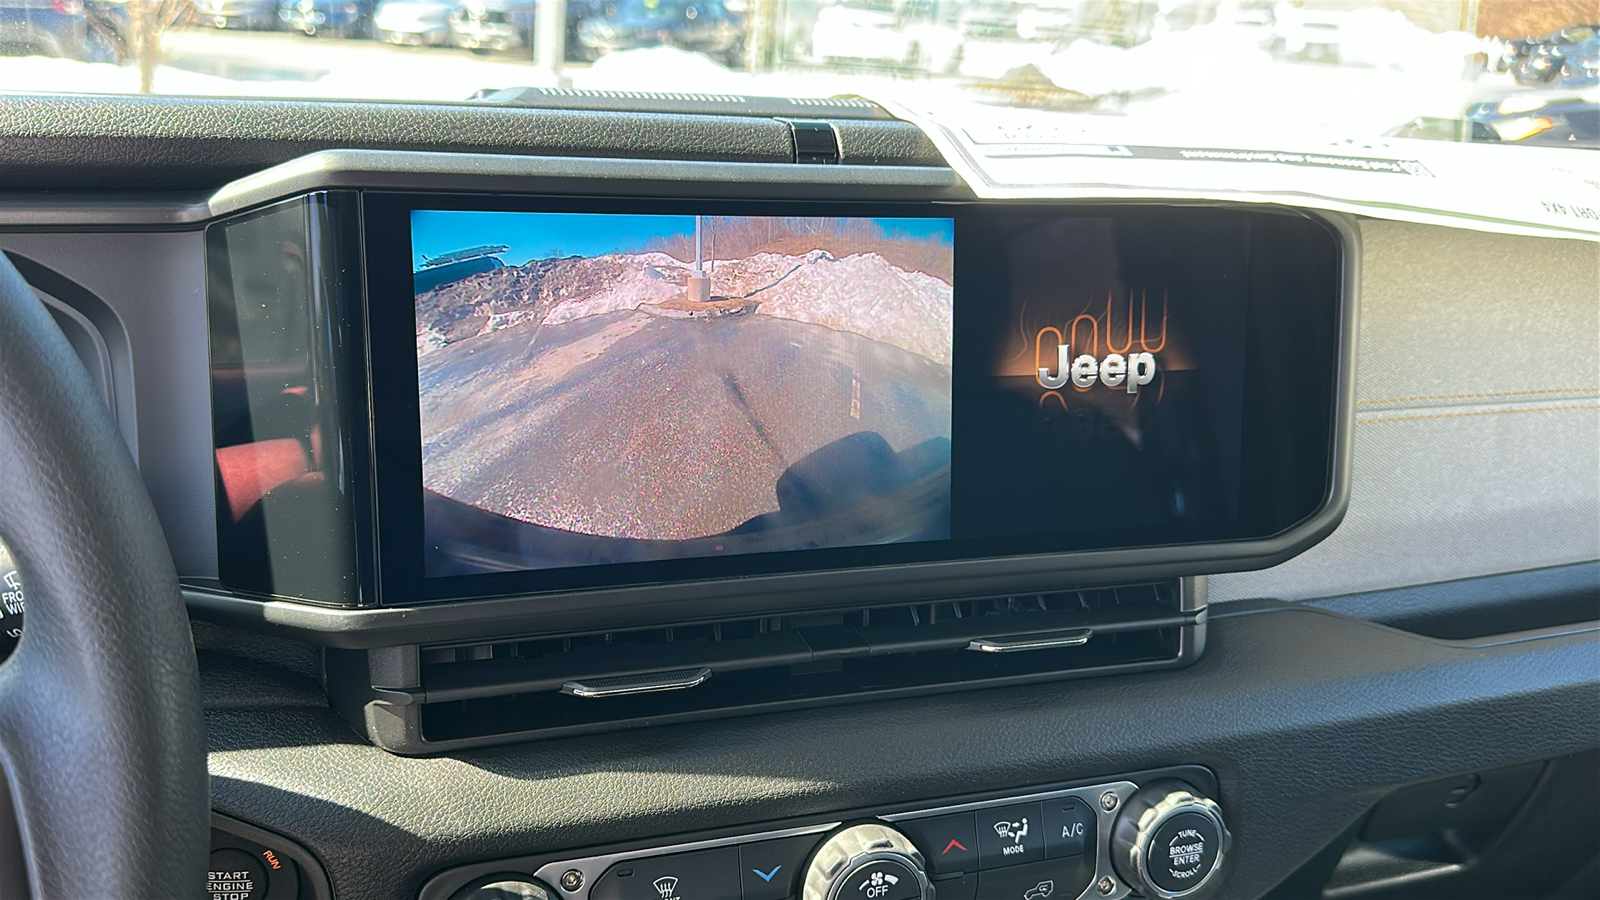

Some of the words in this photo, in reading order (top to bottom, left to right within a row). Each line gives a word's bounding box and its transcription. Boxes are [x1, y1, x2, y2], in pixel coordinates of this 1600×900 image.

[1570, 205, 1600, 220] ORT
[1037, 344, 1156, 394] Jeep
[1061, 822, 1084, 838] A/C
[1178, 829, 1198, 839] TUNE
[1003, 844, 1024, 855] MODE
[1169, 842, 1203, 856] BROWSE
[262, 850, 282, 870] RUN
[1173, 853, 1200, 866] ENTER
[207, 871, 249, 880] START
[1171, 867, 1198, 879] SCROLL
[206, 881, 254, 891] ENGINE
[866, 884, 889, 898] OFF
[213, 892, 249, 900] STOP
